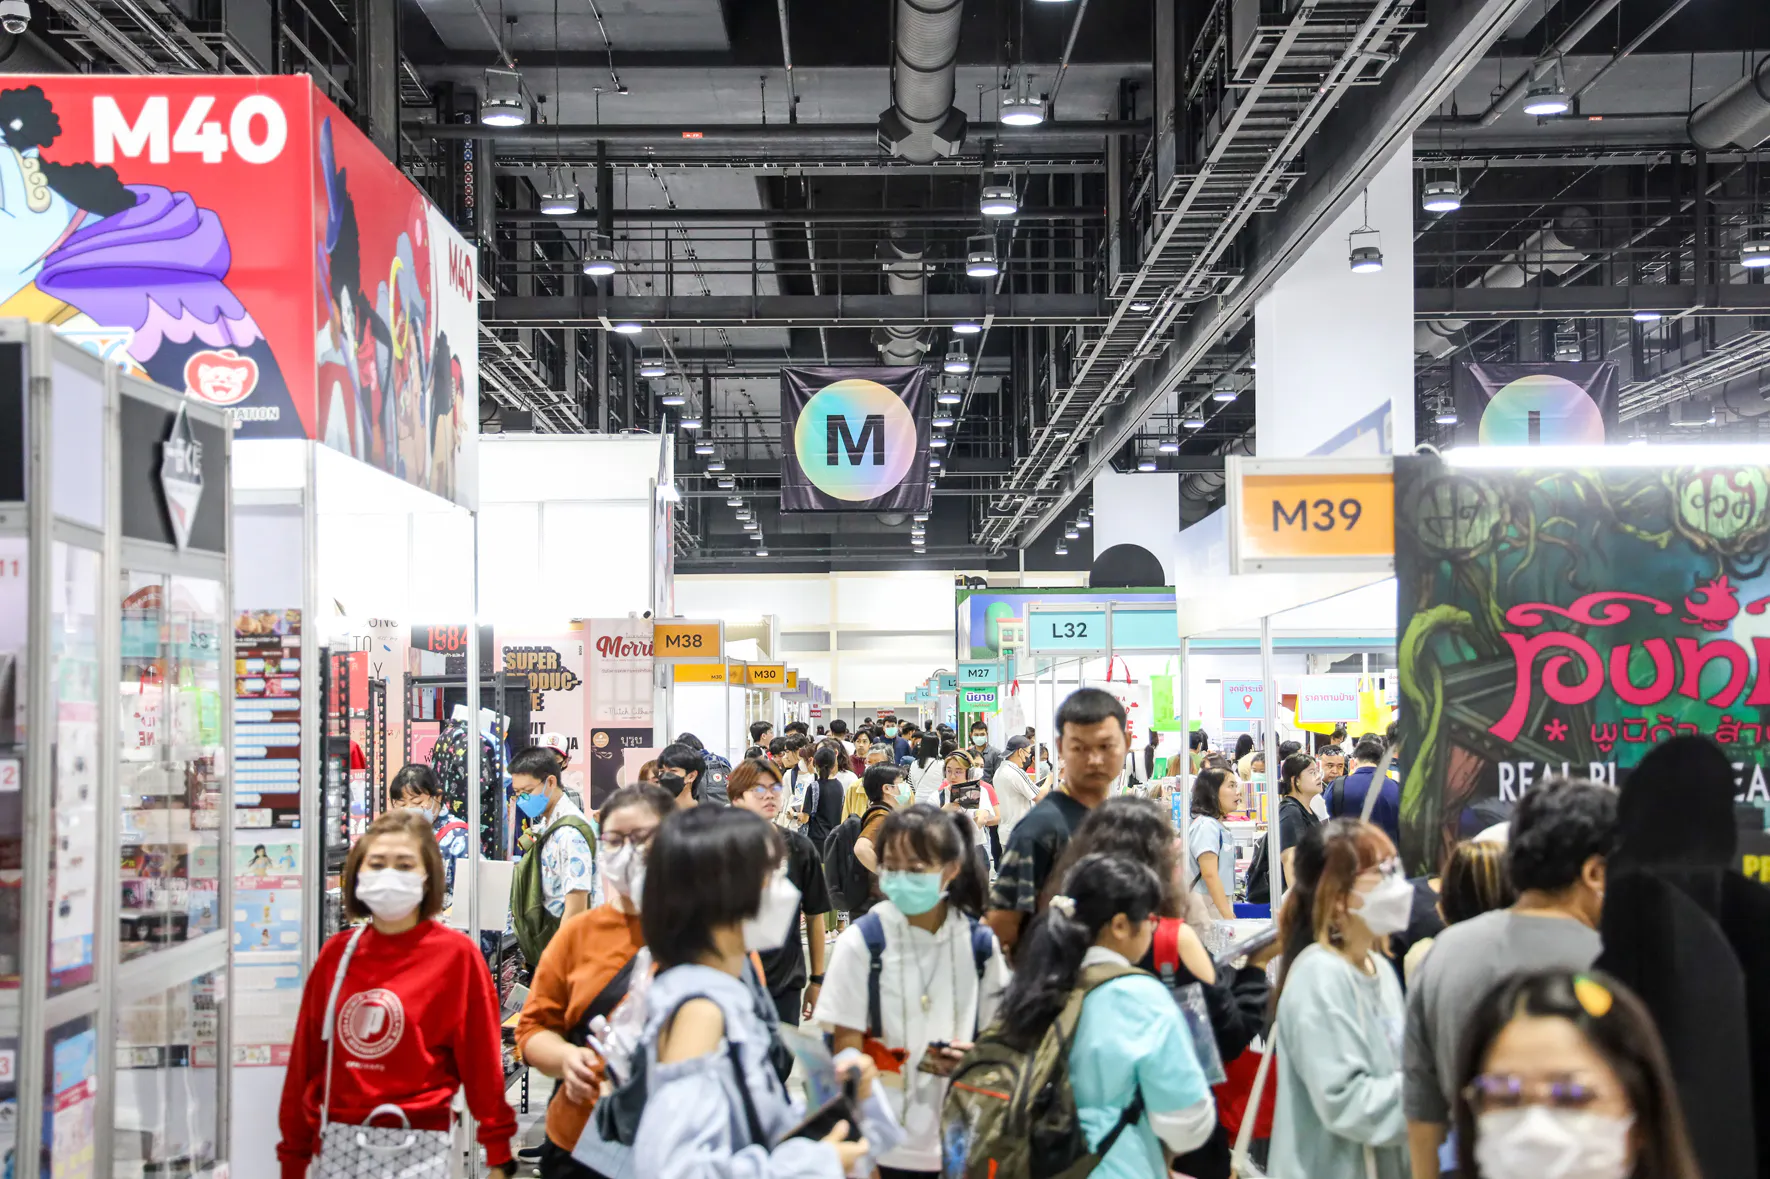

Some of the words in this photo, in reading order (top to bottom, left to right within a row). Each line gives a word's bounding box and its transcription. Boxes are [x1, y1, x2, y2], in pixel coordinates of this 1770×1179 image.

[93, 95, 288, 165] M40
[448, 236, 473, 303] M40
[826, 414, 885, 466] M
[1272, 498, 1363, 532] M39
[1052, 622, 1088, 638] L32
[665, 634, 703, 649] M38
[504, 650, 559, 670] SUPER
[506, 671, 582, 690] ODUC-
[754, 670, 776, 679] M30
[968, 668, 990, 678] M27
[965, 692, 994, 702] นิยาย
[1304, 692, 1355, 702] ราคาตามป้าย
